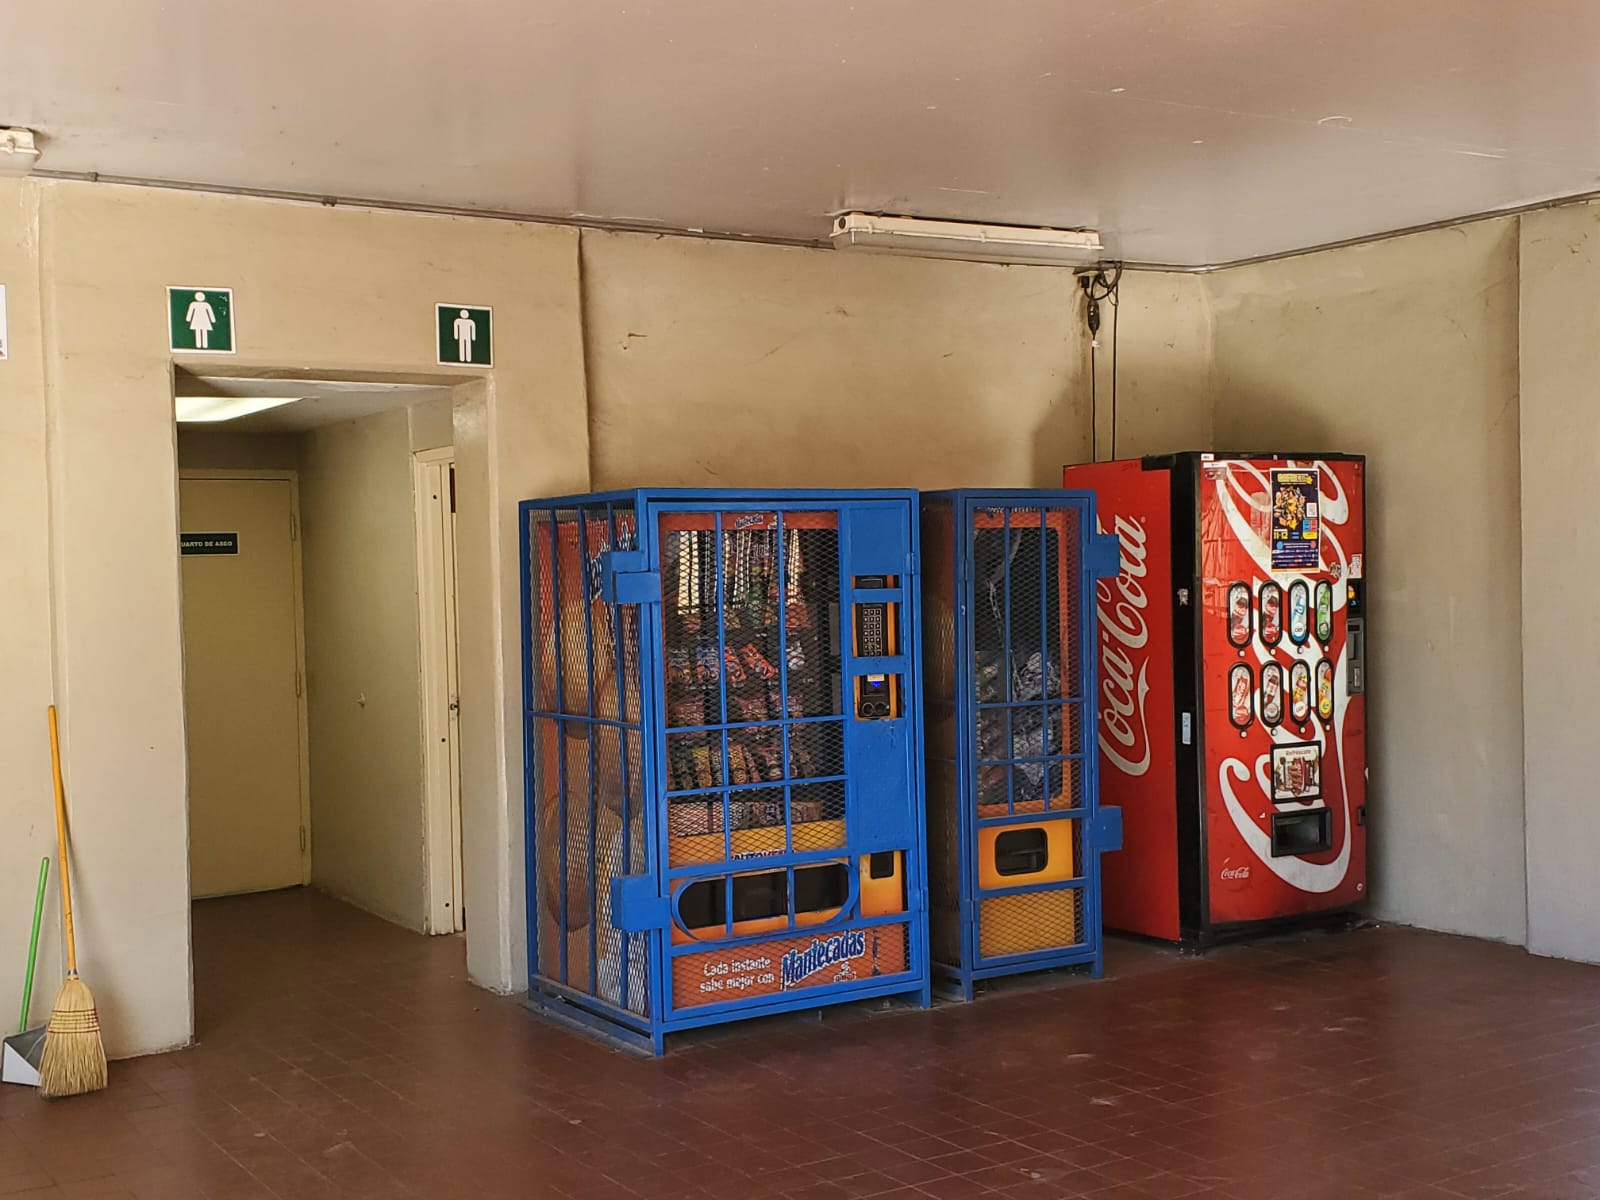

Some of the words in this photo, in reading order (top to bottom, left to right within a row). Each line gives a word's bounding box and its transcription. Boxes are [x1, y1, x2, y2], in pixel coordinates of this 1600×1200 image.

[703, 961, 729, 977] Cada
[731, 956, 771, 973] instante
[781, 930, 865, 991] Mantecadas
[726, 974, 755, 990] mejor
[757, 972, 775, 984] con
